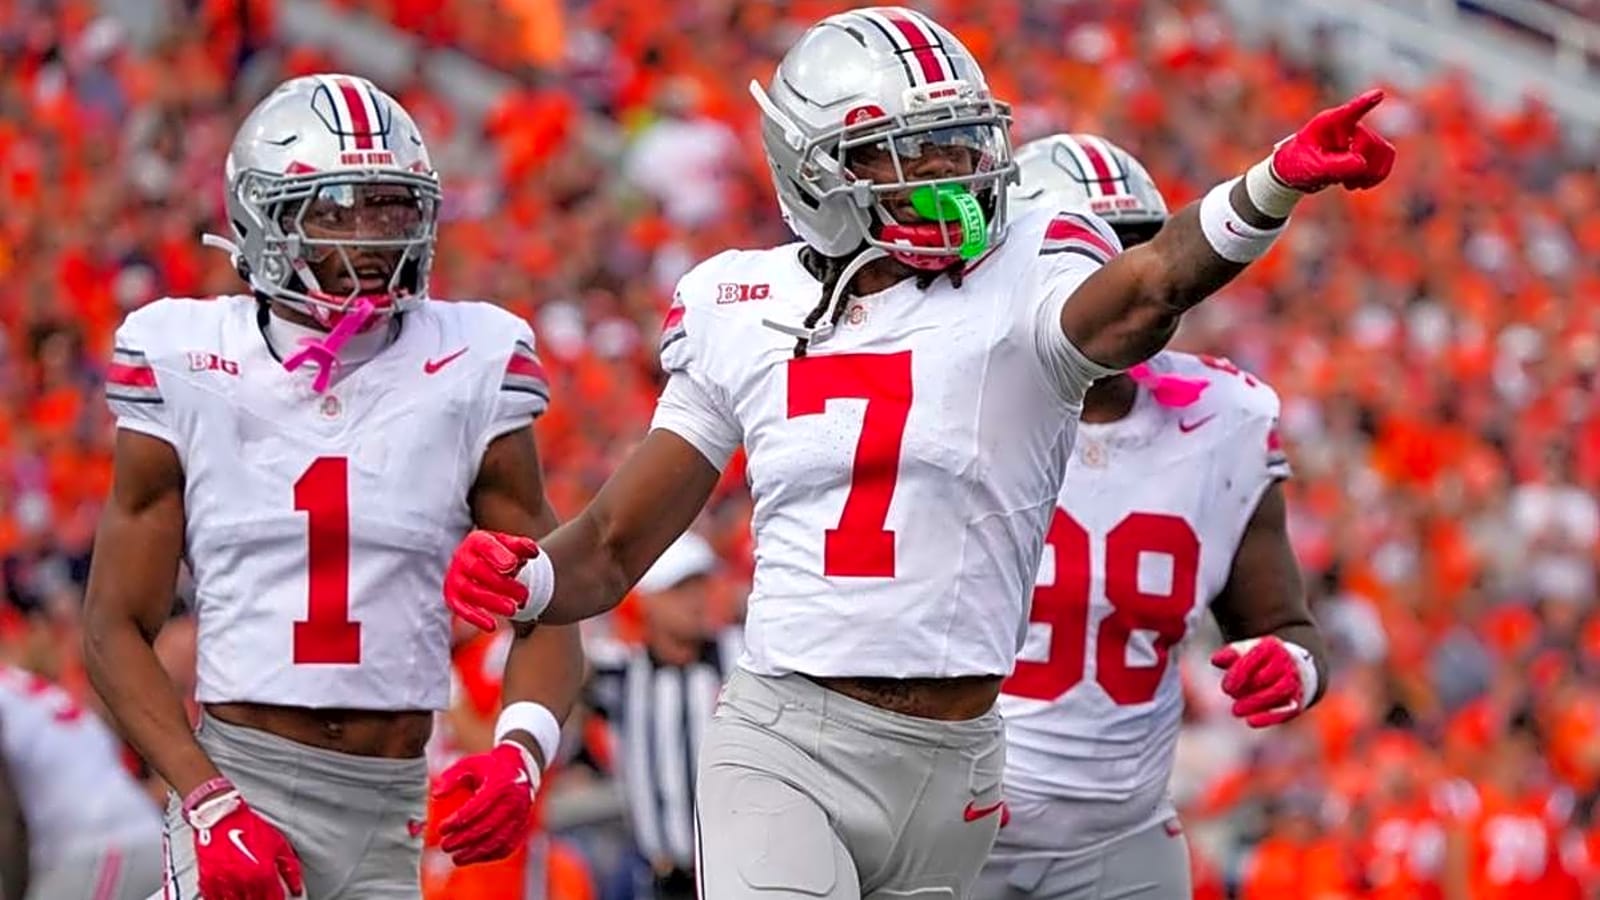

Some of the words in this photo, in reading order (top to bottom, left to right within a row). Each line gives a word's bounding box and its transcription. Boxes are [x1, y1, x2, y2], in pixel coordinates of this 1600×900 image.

[292, 455, 361, 665] 1
[786, 349, 913, 579] 7
[999, 506, 1201, 706] 98
